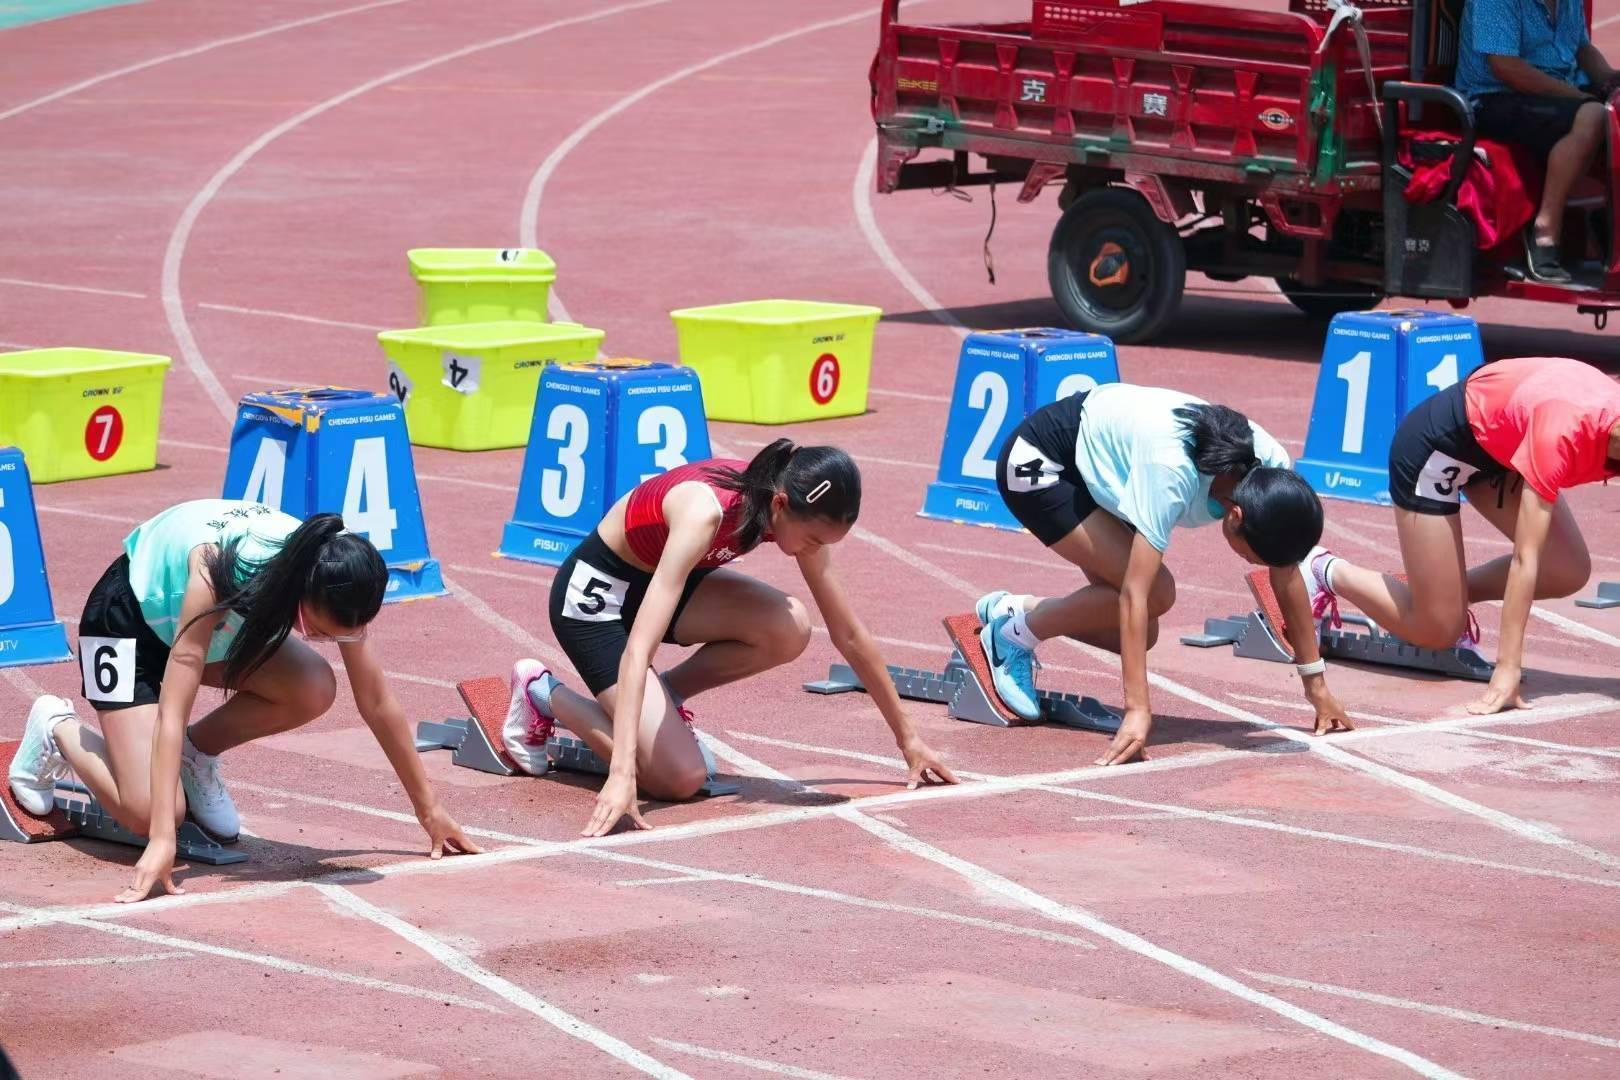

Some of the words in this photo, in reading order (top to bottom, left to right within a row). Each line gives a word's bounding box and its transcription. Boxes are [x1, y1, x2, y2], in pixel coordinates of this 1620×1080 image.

[1021, 79, 1046, 102] 克
[1143, 93, 1168, 116] 赛
[1333, 328, 1358, 337] CHENGDU
[1359, 329, 1371, 338] FISU
[1371, 331, 1390, 340] GAMES
[1416, 335, 1441, 344] CHENGDU
[1441, 334, 1453, 342] FISU
[1454, 333, 1472, 341] GAMES
[514, 361, 541, 369] CROWN
[967, 348, 990, 357] CHENGDU
[991, 350, 1002, 358] FISU
[1002, 351, 1020, 360] GAMES
[1045, 353, 1073, 362] CHENGDU
[1073, 352, 1086, 361] FISU
[1087, 351, 1107, 359] GAMES
[545, 381, 570, 392] CHENGDU
[570, 384, 582, 393] FISU
[582, 386, 601, 395] GAMES
[628, 386, 657, 395] CHENGDU
[658, 385, 671, 393] FISU
[672, 383, 693, 392] GAMES
[817, 360, 835, 398] 6
[82, 388, 109, 398] CROWN
[1337, 351, 1372, 454] 1
[328, 416, 358, 426] CHENGDU
[359, 415, 373, 424] FISU
[374, 413, 397, 422] GAMES
[961, 371, 1009, 480] 2
[95, 414, 114, 454] 7
[637, 405, 688, 484] 3
[540, 403, 589, 518] 3
[1015, 458, 1044, 486] 4
[1339, 477, 1361, 487] FISU
[1434, 466, 1460, 496] 3
[341, 436, 398, 550] 4
[577, 577, 612, 615] 5
[94, 645, 119, 694] 6
